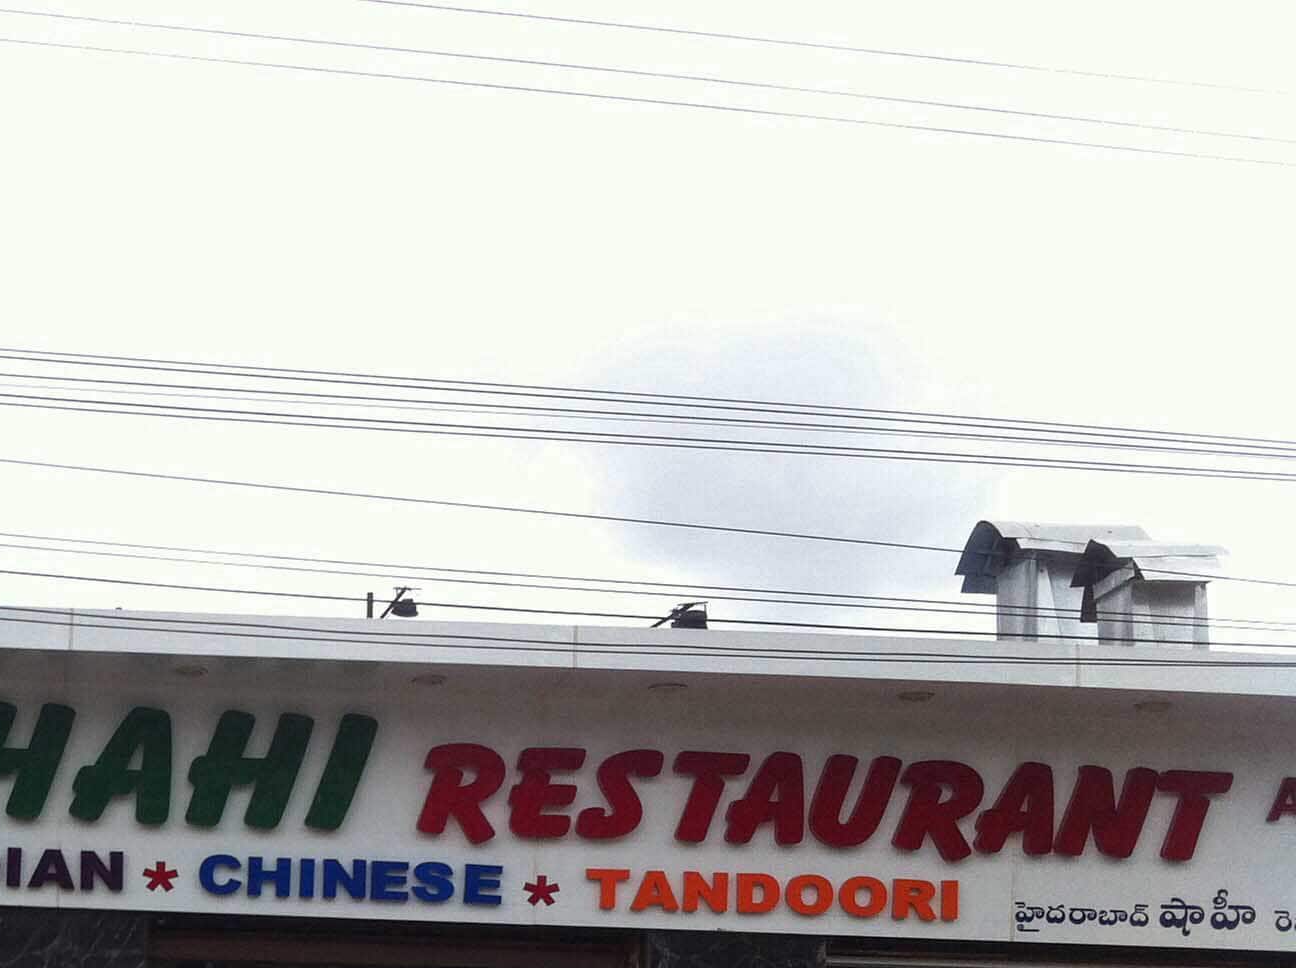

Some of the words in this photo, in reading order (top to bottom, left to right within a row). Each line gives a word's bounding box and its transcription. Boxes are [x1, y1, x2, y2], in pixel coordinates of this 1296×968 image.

[416, 743, 1234, 864] RESTAURANT
[198, 854, 503, 905] CHINESE
[585, 868, 959, 922] TANDOORI
